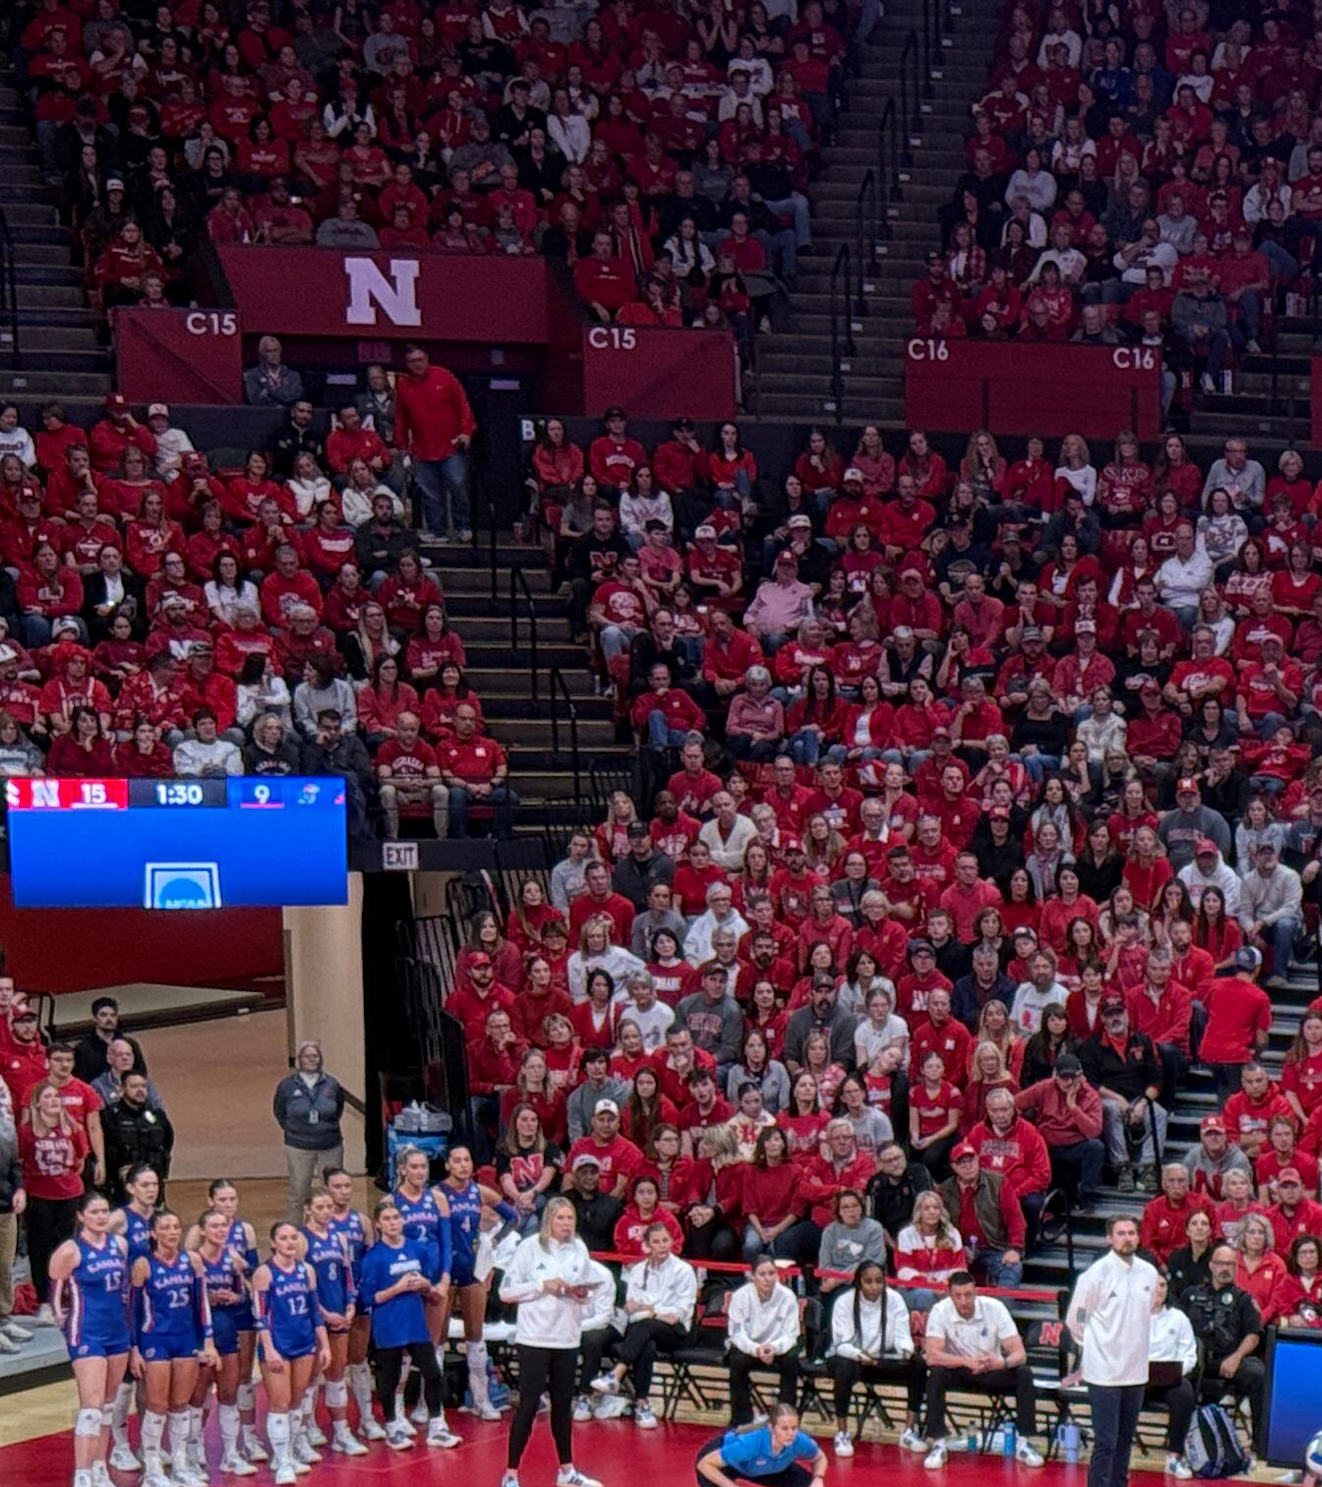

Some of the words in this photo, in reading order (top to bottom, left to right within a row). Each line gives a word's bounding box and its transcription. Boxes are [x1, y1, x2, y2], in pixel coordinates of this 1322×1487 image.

[345, 257, 421, 326] N
[186, 312, 237, 335] C15
[588, 327, 637, 350] C15
[907, 338, 949, 361] C16
[1113, 347, 1155, 370] C16
[31, 781, 60, 808] N
[80, 784, 107, 803] 15
[156, 784, 203, 804] 1:30
[254, 784, 271, 804] 9
[386, 846, 415, 866] EXIT
[510, 1153, 544, 1187] N
[416, 1224, 428, 1242] 2
[461, 1214, 471, 1233] 4
[104, 1271, 122, 1292] 15
[167, 1287, 190, 1308] 25
[288, 1295, 309, 1316] 12
[1038, 1322, 1064, 1346] N
